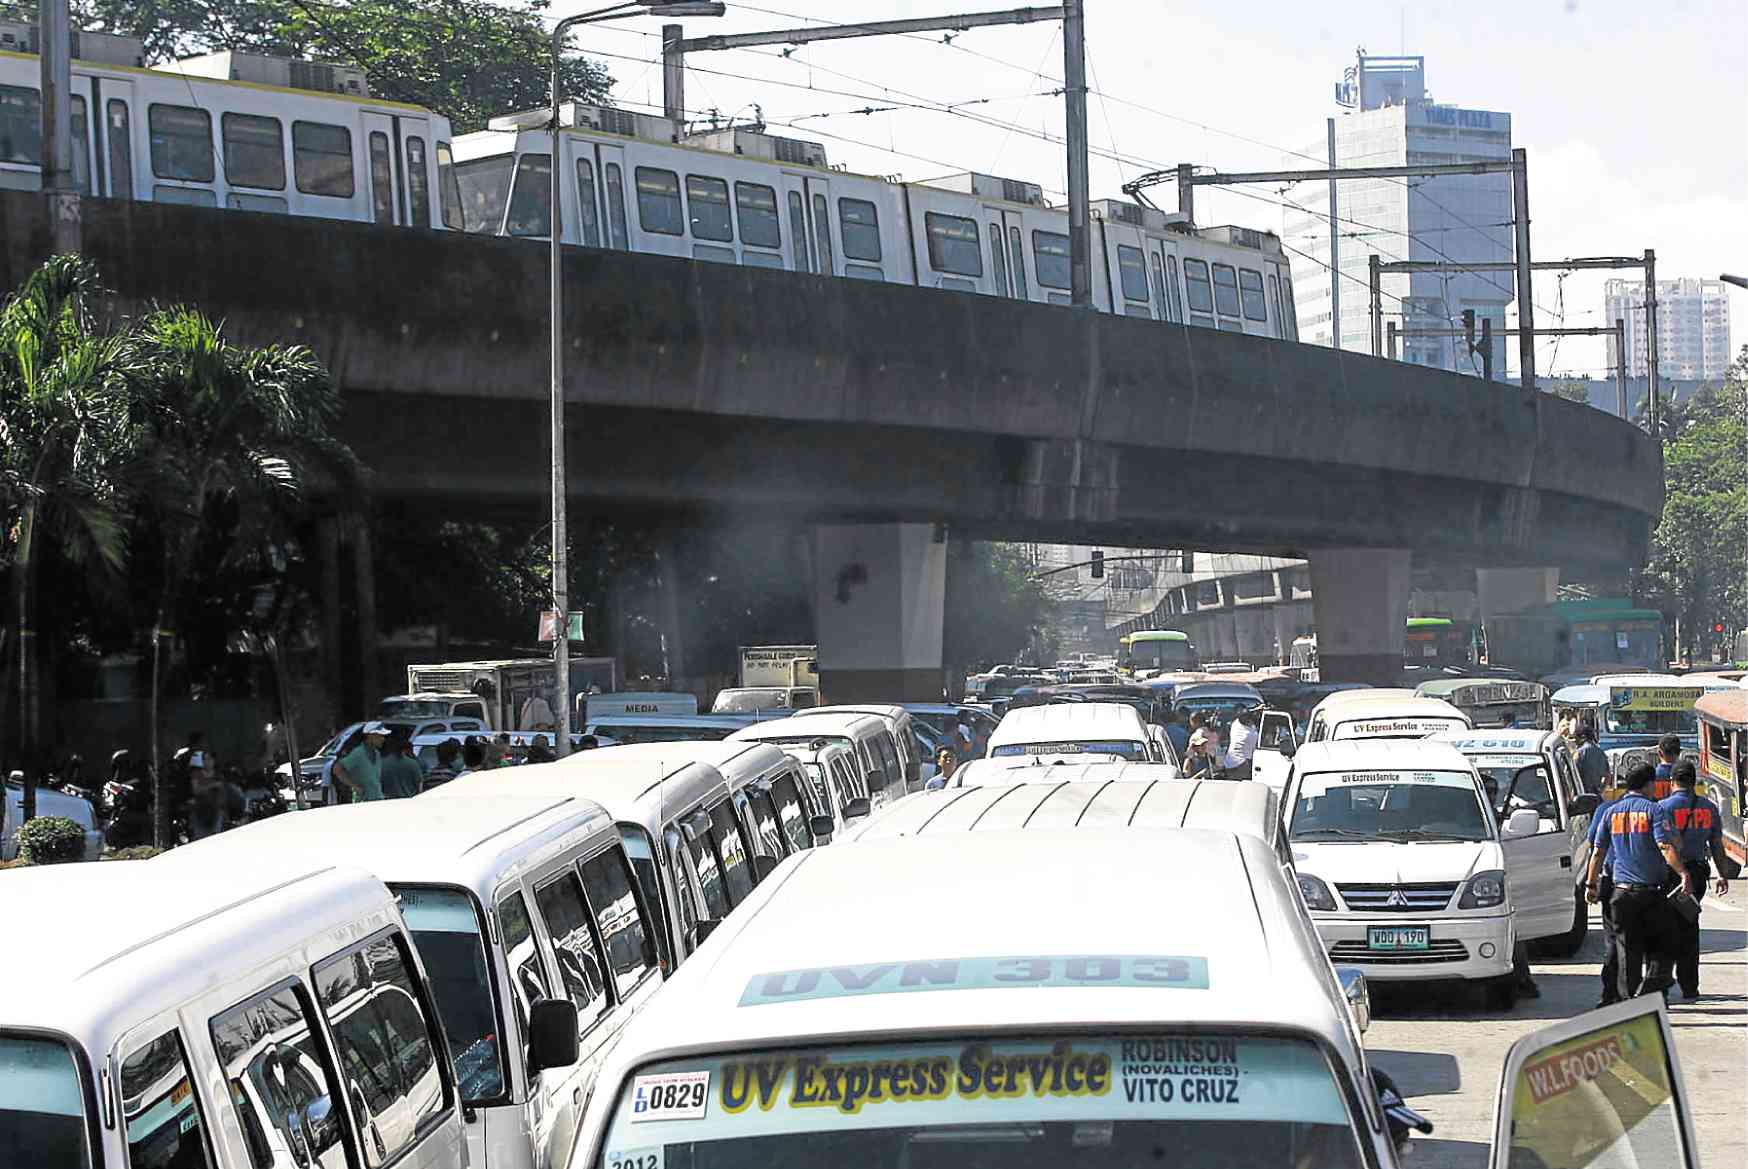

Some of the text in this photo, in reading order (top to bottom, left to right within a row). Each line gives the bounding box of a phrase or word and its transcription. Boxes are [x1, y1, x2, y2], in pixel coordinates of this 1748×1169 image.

[1458, 110, 1491, 128] PLAZA
[625, 704, 658, 713] MEDIA
[1366, 723, 1392, 733] Express
[1393, 722, 1418, 731] Service
[1352, 774, 1376, 783] Express
[1376, 773, 1400, 782] Service
[1405, 930, 1425, 944] 190
[761, 958, 1190, 997] UVN 303
[1121, 1040, 1238, 1063] ROBINSON
[720, 1043, 1111, 1114] UV Express Service
[1122, 1064, 1240, 1079] (NOVALICHES)
[650, 1082, 705, 1110] 0829
[1123, 1078, 1240, 1104] VITO CRUZ
